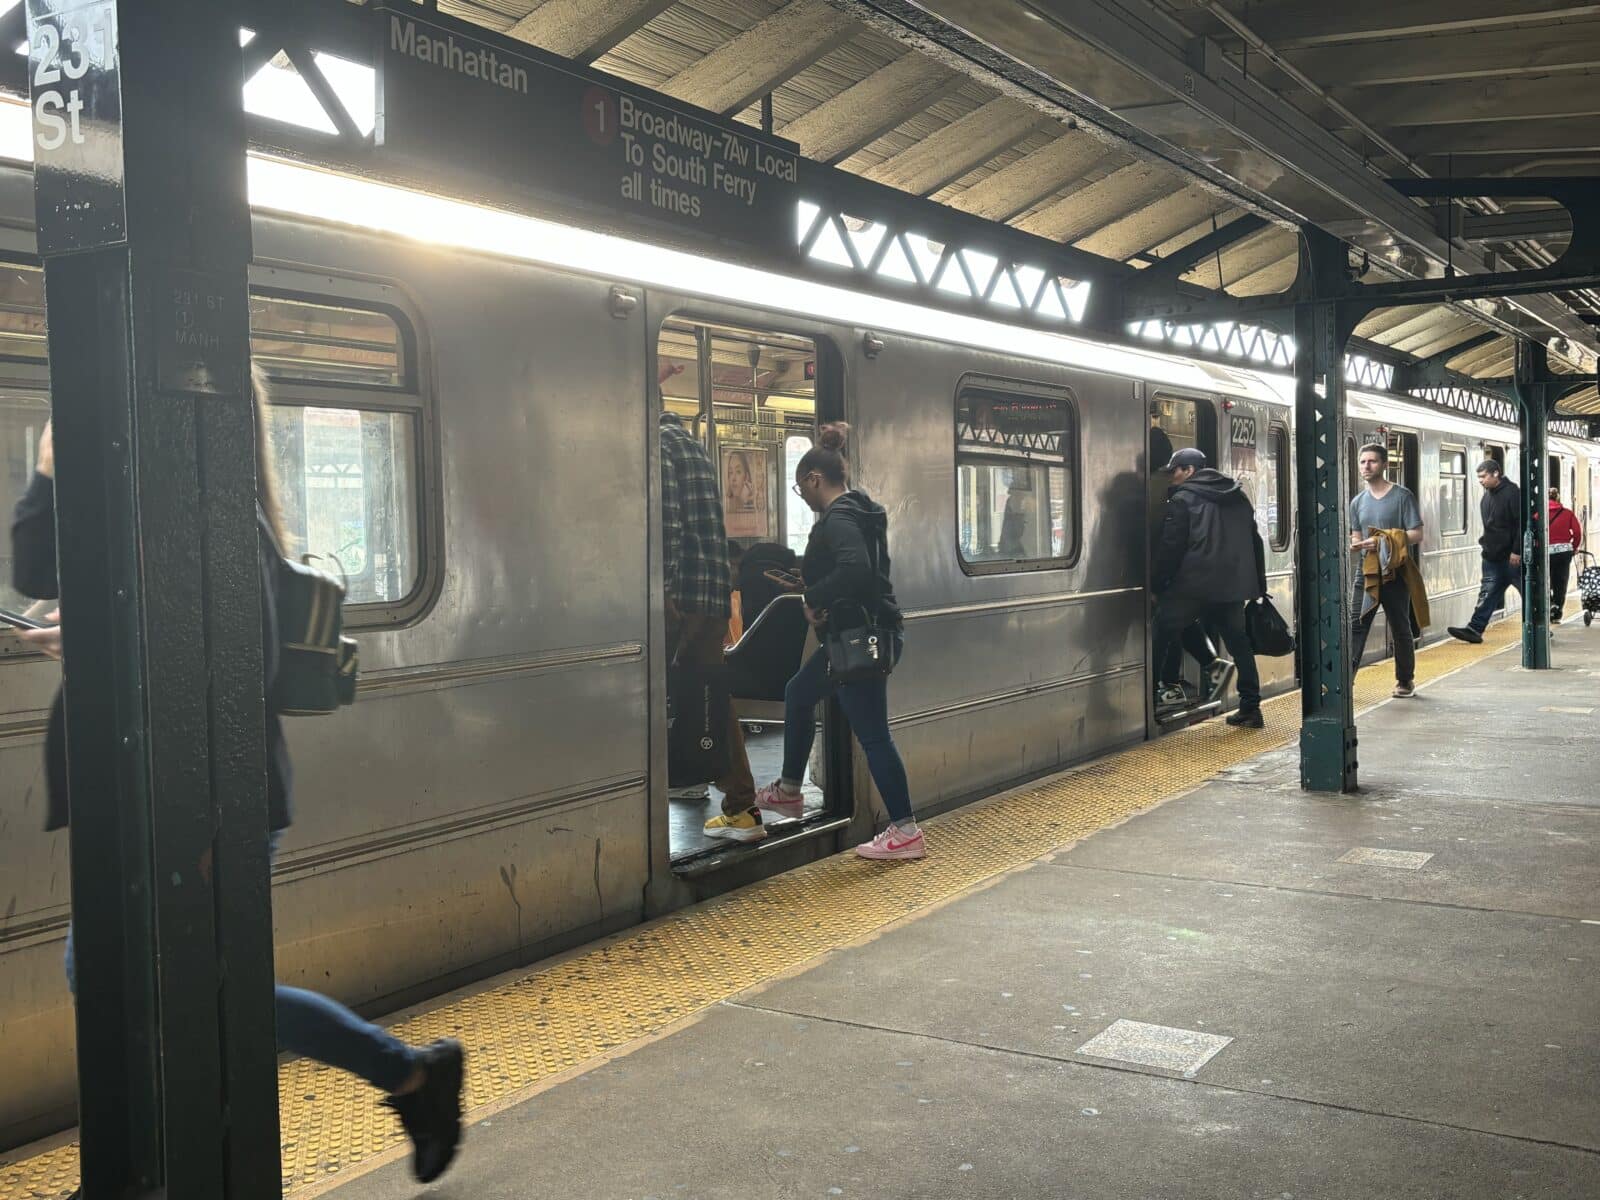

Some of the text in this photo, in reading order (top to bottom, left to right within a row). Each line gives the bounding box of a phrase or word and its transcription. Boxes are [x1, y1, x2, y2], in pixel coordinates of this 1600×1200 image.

[33, 8, 115, 87] 231
[390, 17, 528, 94] Manhattan
[35, 89, 85, 150] St
[619, 96, 798, 183] Broadway-7Av Local
[621, 132, 757, 206] To South Ferry
[621, 173, 701, 218] all times
[1232, 417, 1255, 445] 2252
